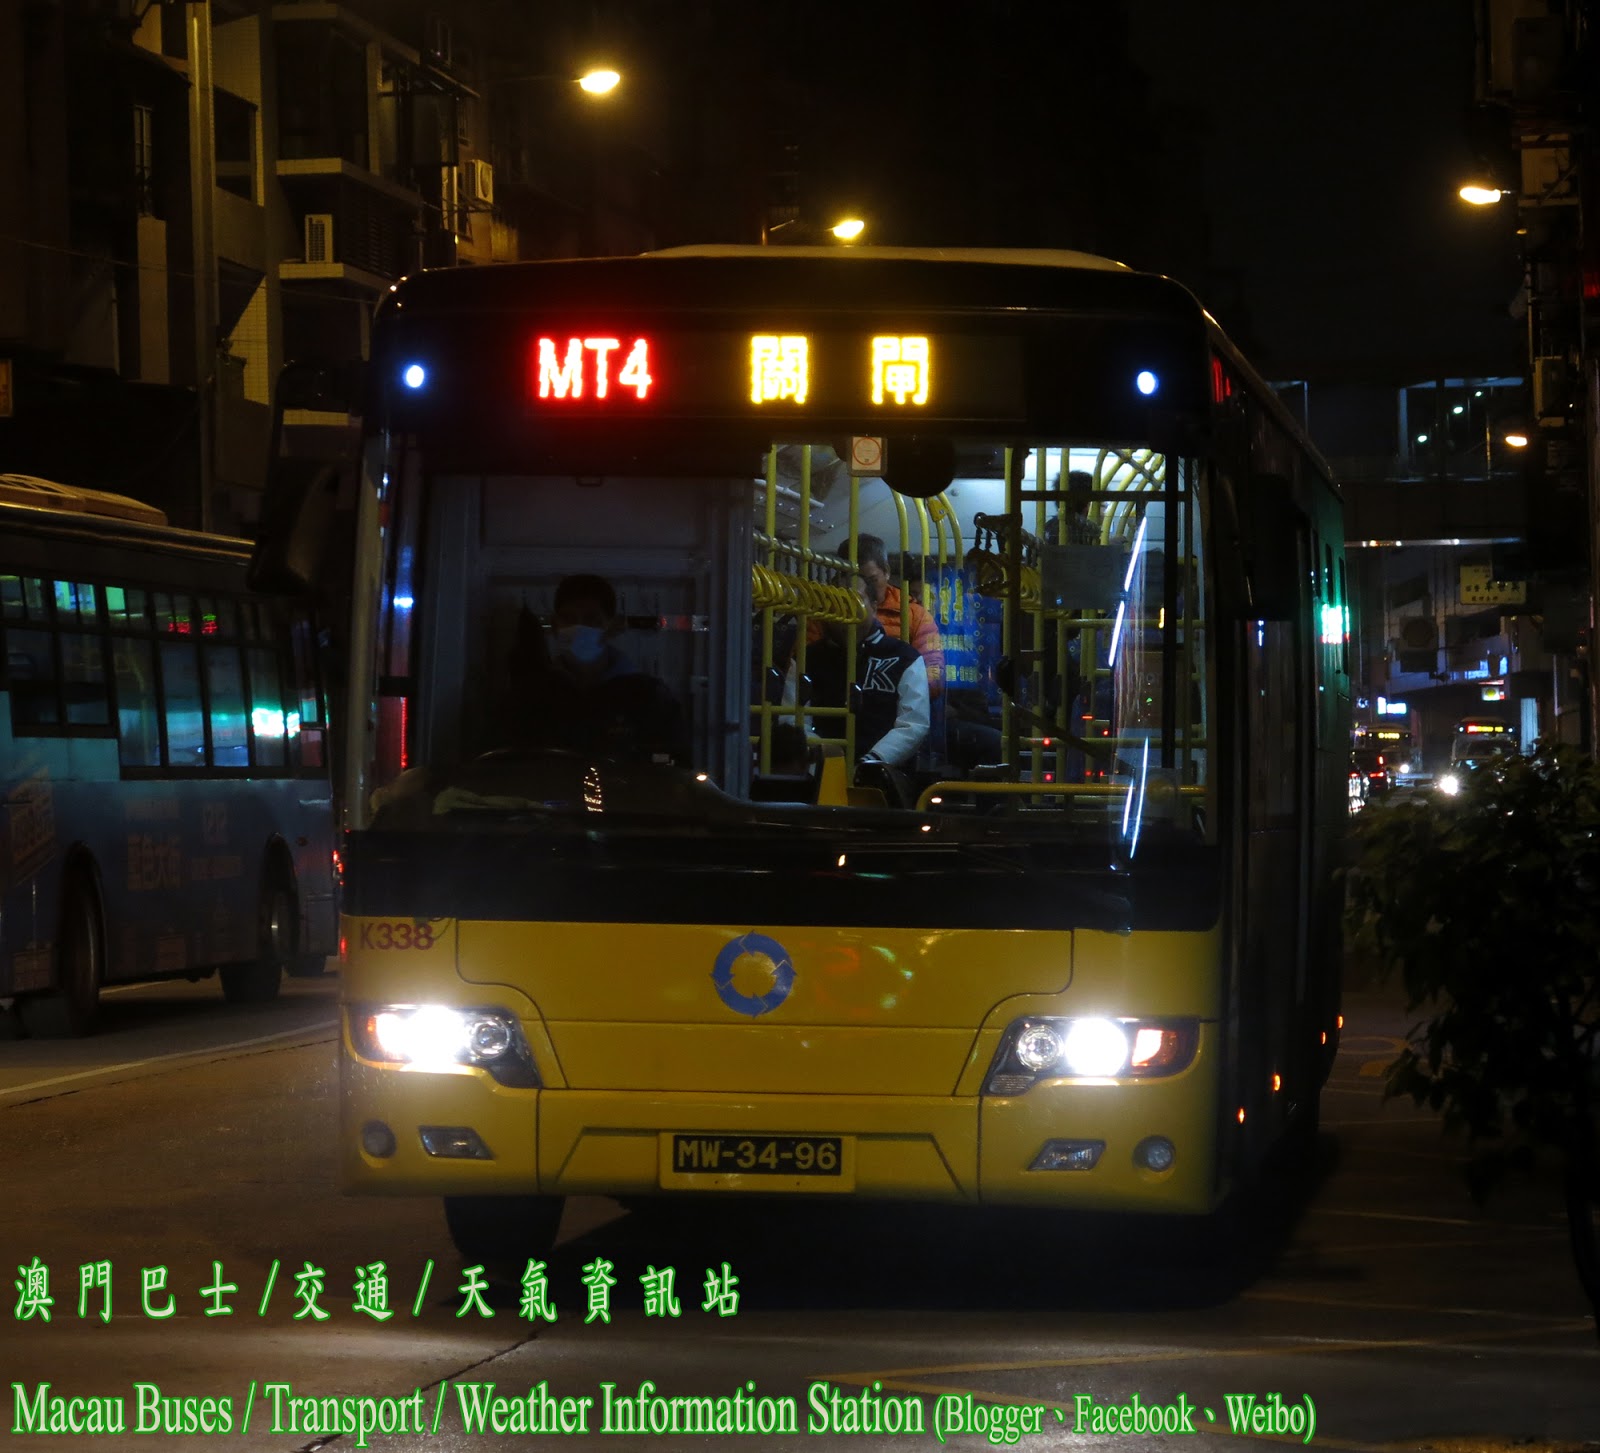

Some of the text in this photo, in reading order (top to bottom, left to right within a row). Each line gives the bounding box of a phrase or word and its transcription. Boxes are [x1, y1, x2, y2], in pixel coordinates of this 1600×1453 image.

[538, 337, 652, 398] MT4
[863, 656, 900, 692] K
[361, 923, 433, 951] K338
[678, 1140, 837, 1170] MW-34-96
